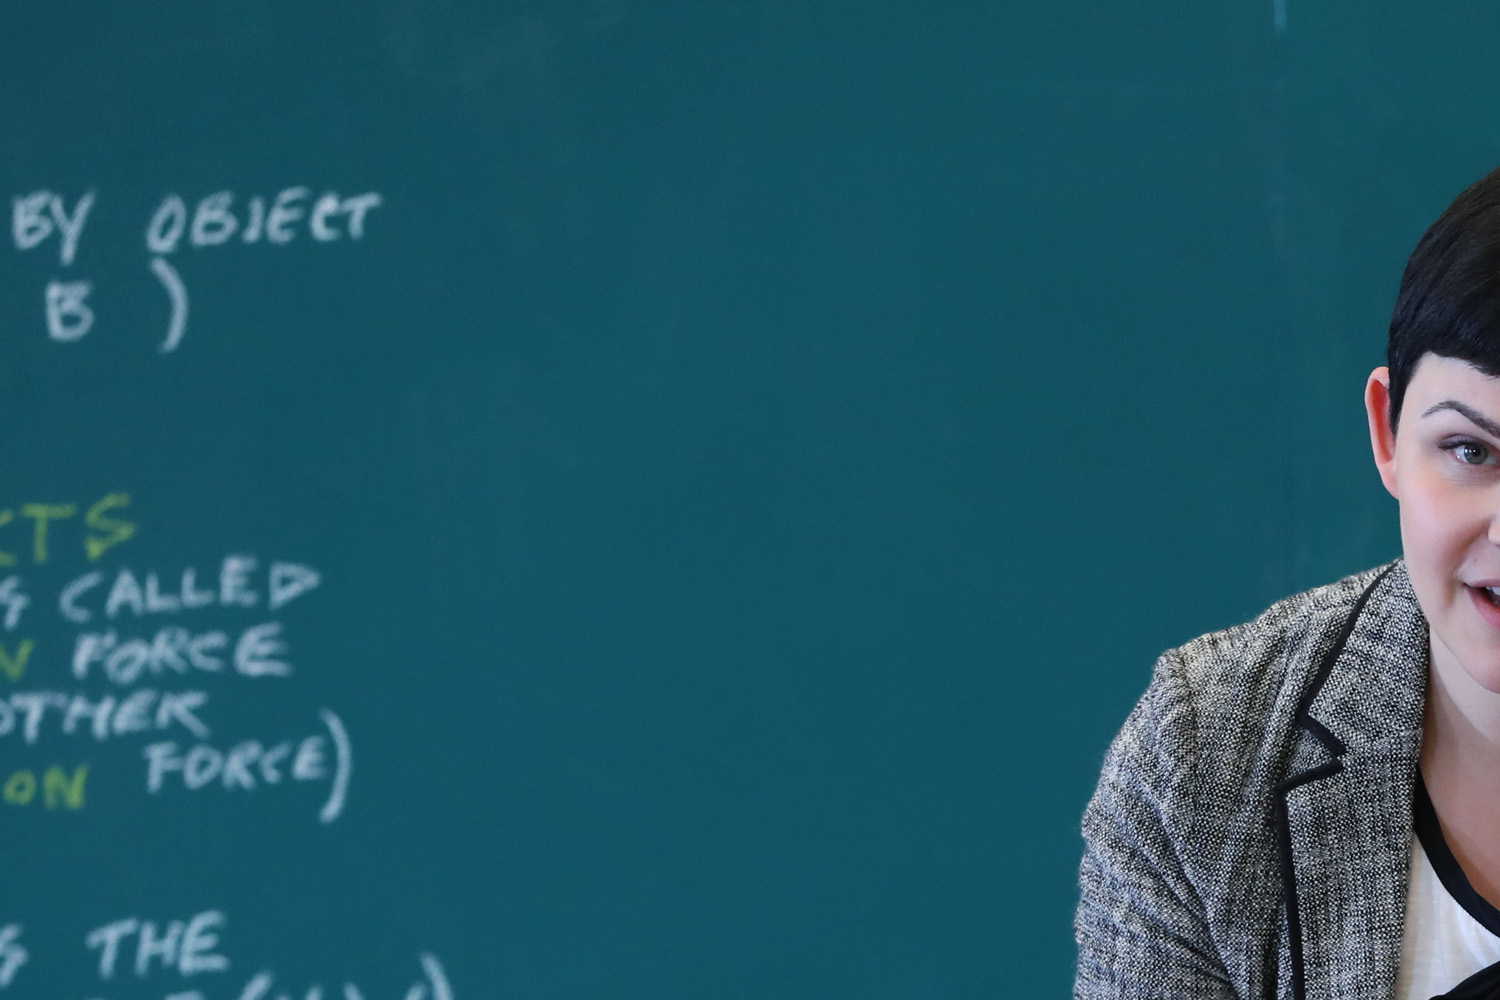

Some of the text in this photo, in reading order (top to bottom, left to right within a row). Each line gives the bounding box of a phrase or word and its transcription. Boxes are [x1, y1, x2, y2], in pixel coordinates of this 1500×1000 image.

[12, 185, 384, 267] BY OBJECT
[44, 278, 95, 343] B
[59, 553, 322, 624] CALLED
[71, 621, 293, 686] FORCE
[2, 764, 89, 811] ON
[85, 909, 231, 980] THE
